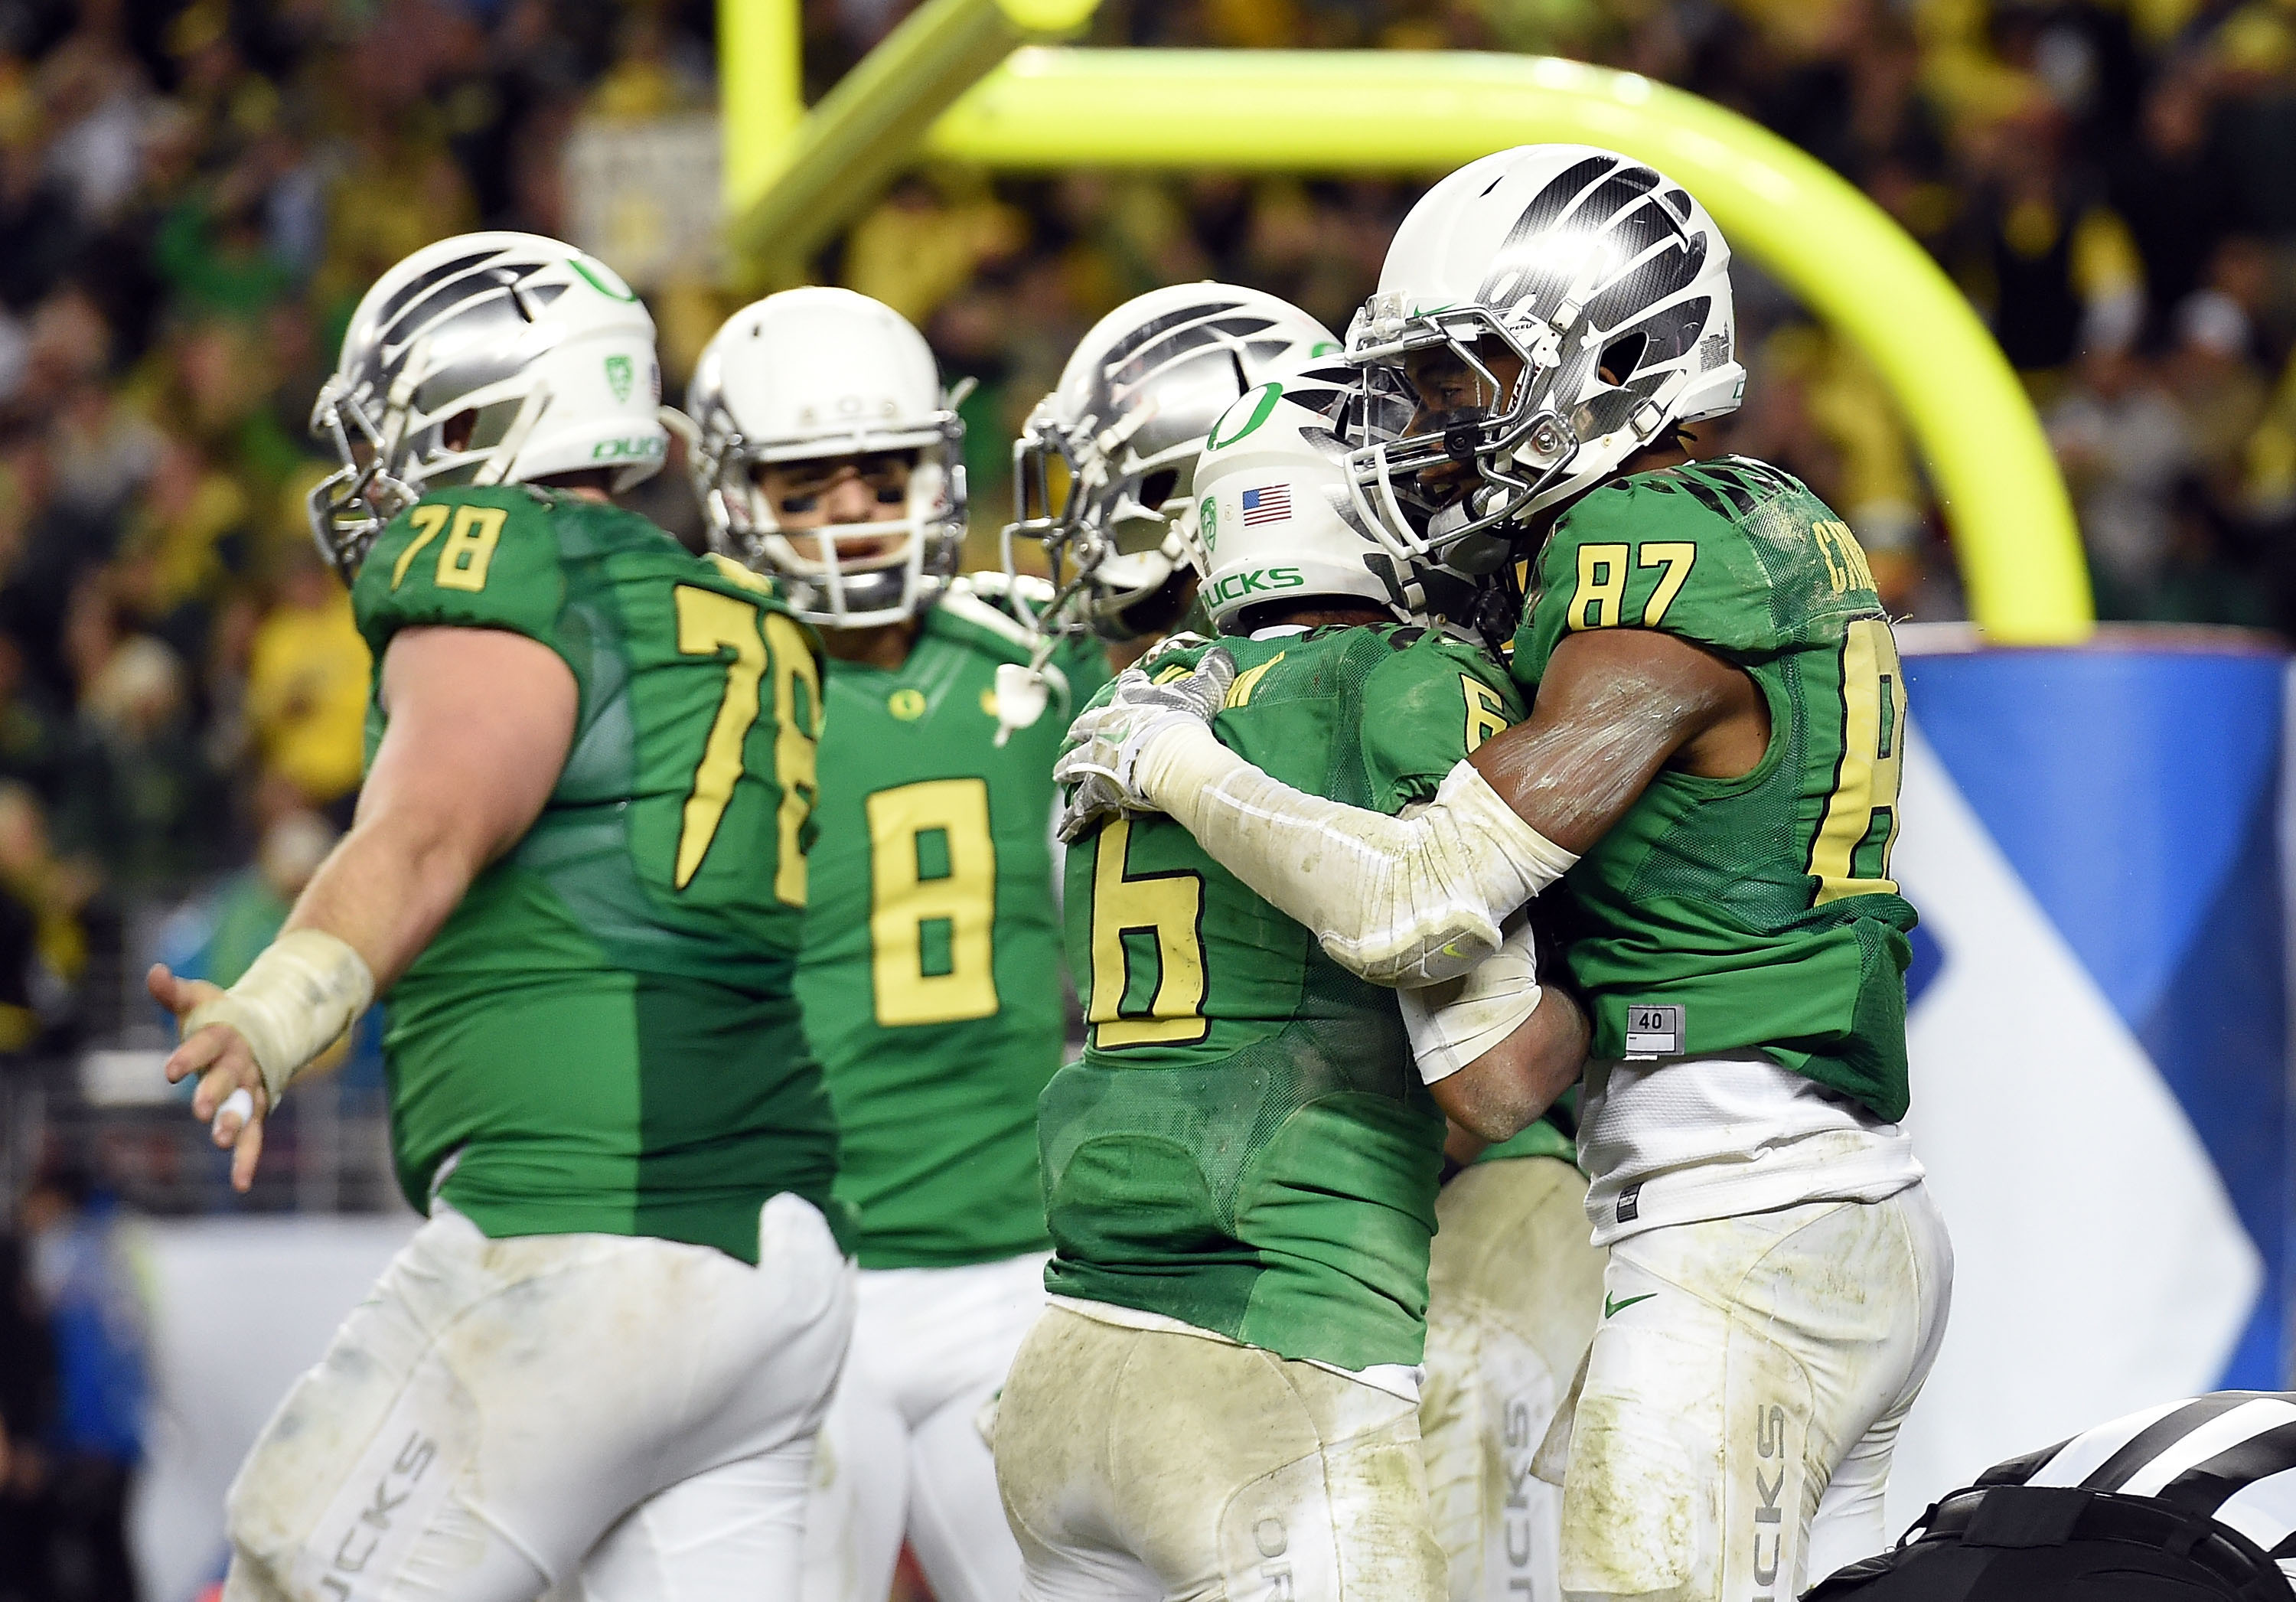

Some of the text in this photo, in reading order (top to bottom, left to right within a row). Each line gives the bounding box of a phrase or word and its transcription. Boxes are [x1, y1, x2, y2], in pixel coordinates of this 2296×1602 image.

[390, 504, 508, 592] 78
[1567, 542, 1698, 631] 87
[673, 583, 825, 909] 78
[1458, 672, 1509, 754] 6
[866, 777, 1000, 1027] 8
[1088, 811, 1214, 1050] 6
[1639, 1012, 1662, 1029] 40
[1752, 1404, 1784, 1602] CKS
